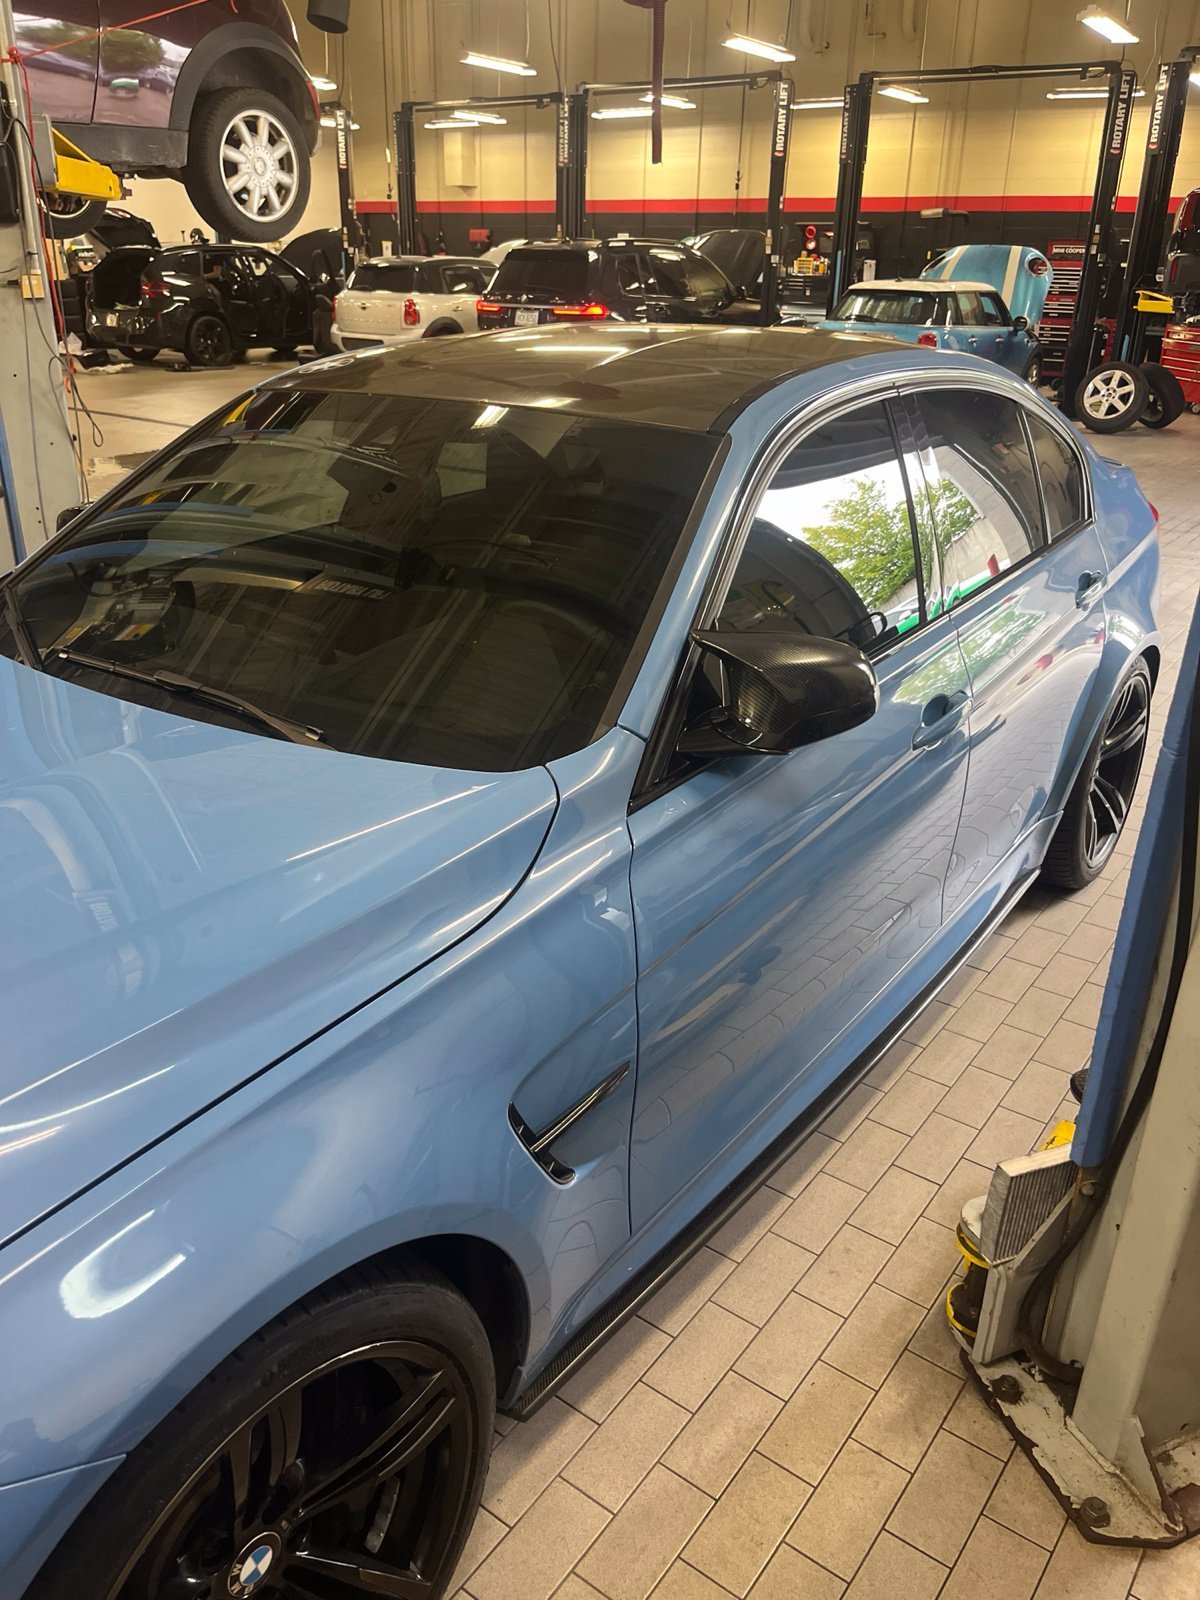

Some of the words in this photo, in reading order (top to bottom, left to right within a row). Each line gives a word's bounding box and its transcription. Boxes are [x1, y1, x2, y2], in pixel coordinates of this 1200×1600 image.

[779, 83, 789, 106] LIFT
[1119, 75, 1131, 99] LIFT
[1150, 94, 1164, 142] ROTARY
[1158, 65, 1169, 91] LIFT
[336, 110, 346, 129] LIFT
[776, 108, 787, 151] ROTARY
[841, 112, 849, 153] ROTARY
[1112, 102, 1127, 148] ROTARY
[337, 130, 347, 165] ROTARY
